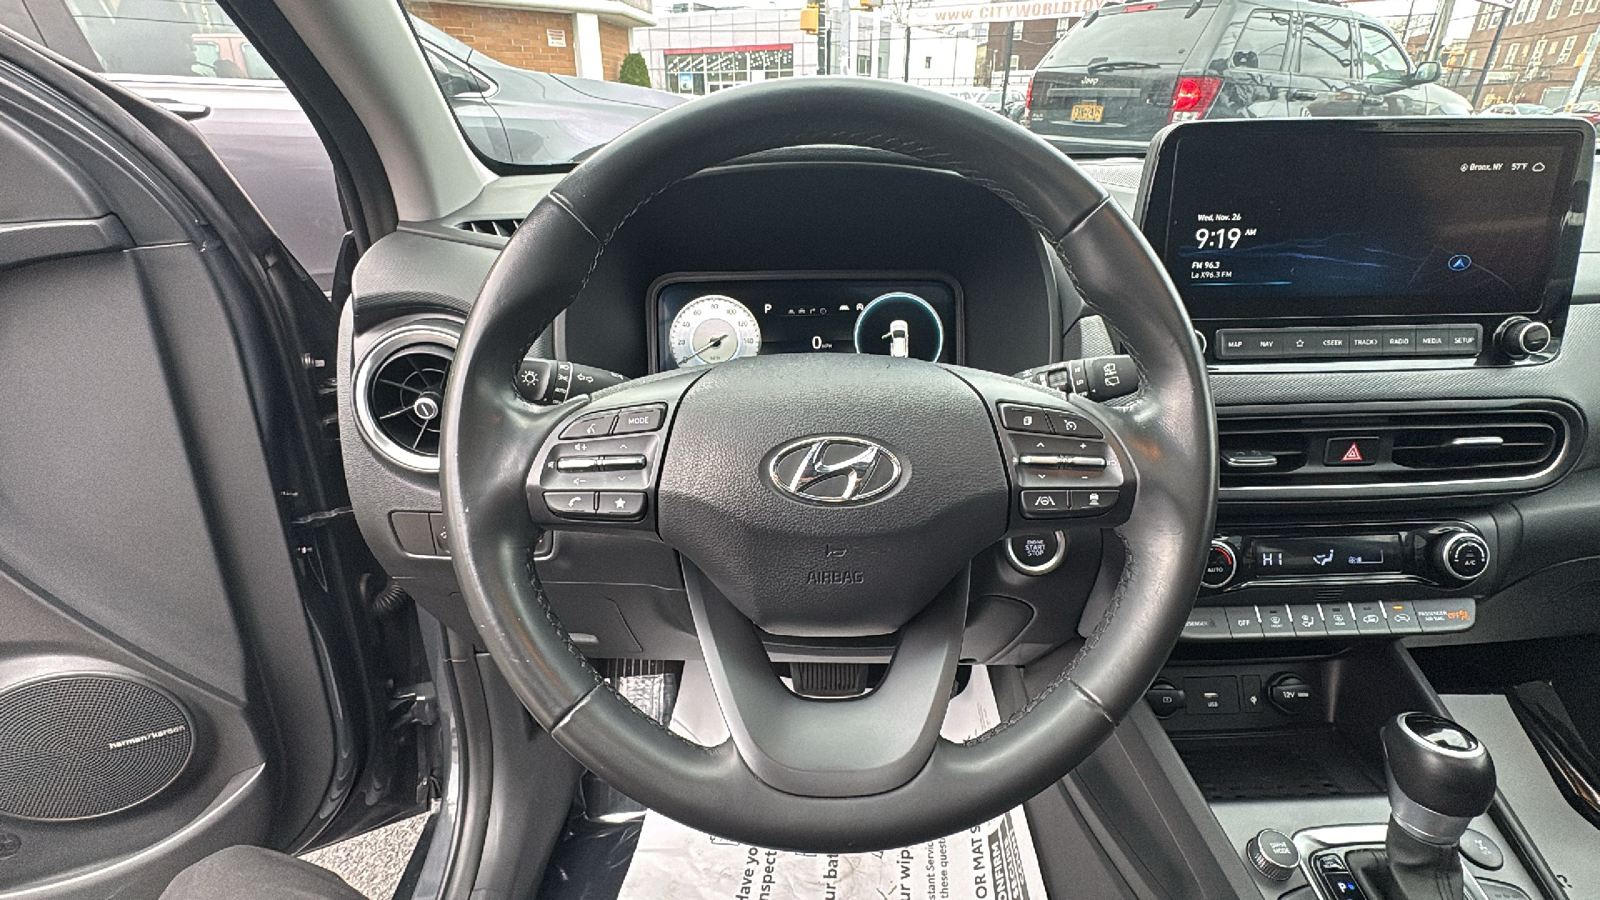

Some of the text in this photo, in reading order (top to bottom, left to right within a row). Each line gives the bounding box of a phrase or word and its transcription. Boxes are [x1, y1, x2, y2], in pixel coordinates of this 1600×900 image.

[1081, 77, 1098, 85] Jeep
[1492, 162, 1504, 171] NY
[1197, 213, 1242, 222] Wed, Nov. 26
[1195, 227, 1258, 249] 9:19 AM
[1191, 261, 1221, 269] FM 96.3
[1190, 271, 1199, 279] La
[1221, 270, 1233, 278] FM
[693, 308, 702, 316] 60
[726, 307, 737, 315] 100
[764, 303, 773, 314] P
[681, 320, 691, 328] 40
[737, 320, 749, 328] 120
[677, 338, 686, 346] 20
[743, 336, 754, 345] 140
[811, 335, 822, 350] 0
[1259, 340, 1274, 348] NAV
[1389, 337, 1409, 345] RADIO
[1453, 336, 1475, 344] SETUP
[627, 416, 650, 425] MODE
[806, 570, 865, 585] AIRBAG
[1269, 841, 1287, 849] DRIVE
[971, 837, 985, 871] MAT
[1272, 846, 1292, 854] MODE
[939, 869, 949, 899] these
[1337, 882, 1347, 893] P
